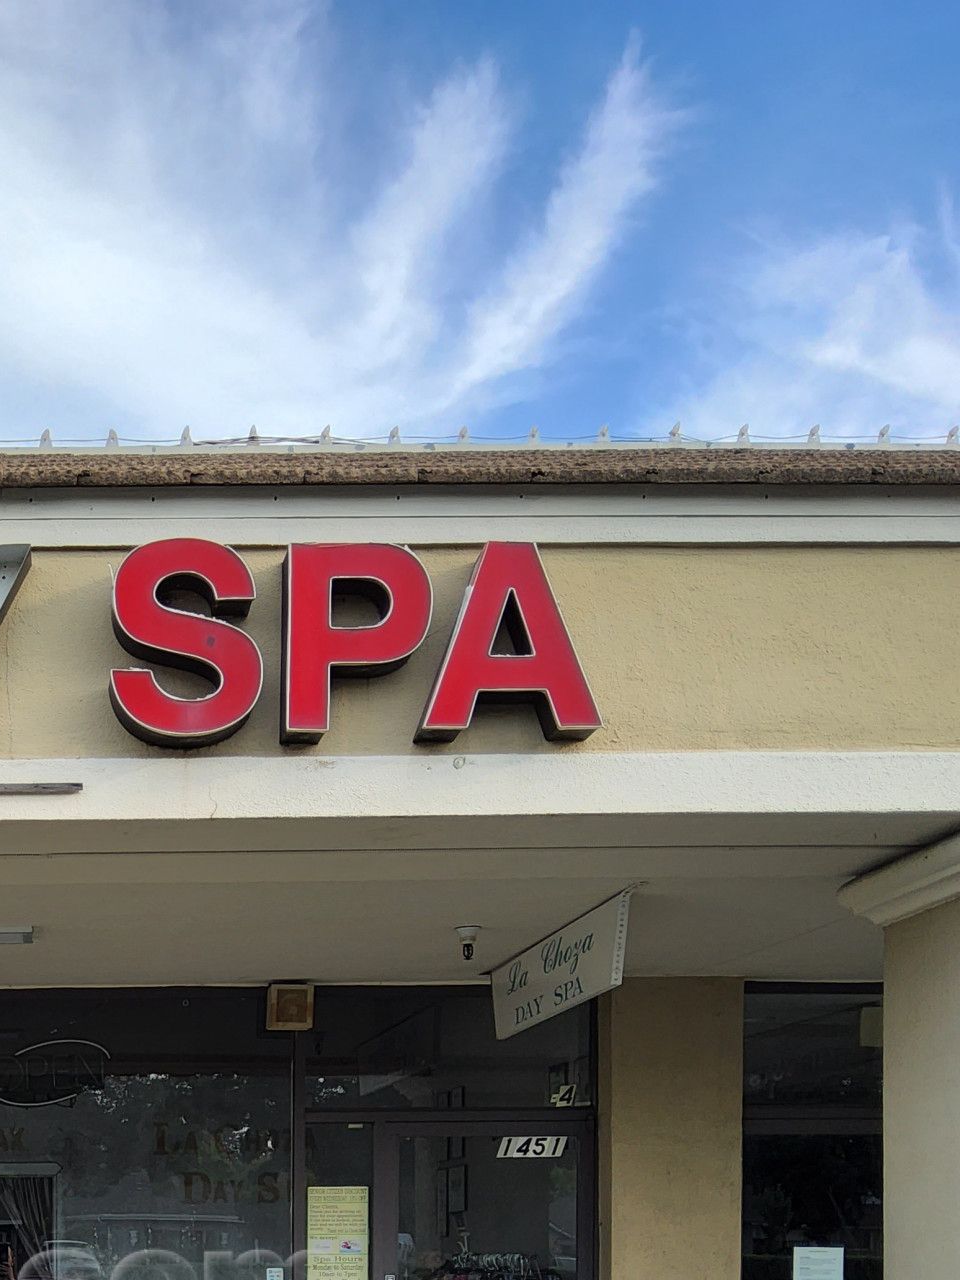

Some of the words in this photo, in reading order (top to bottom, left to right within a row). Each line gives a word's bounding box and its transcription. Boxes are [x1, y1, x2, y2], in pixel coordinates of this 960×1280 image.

[109, 538, 604, 748] SPA
[507, 961, 529, 996] La
[541, 933, 594, 975] Choza
[515, 994, 544, 1025] DAY
[554, 976, 584, 1007] SPA
[503, 1137, 561, 1157] 1451
